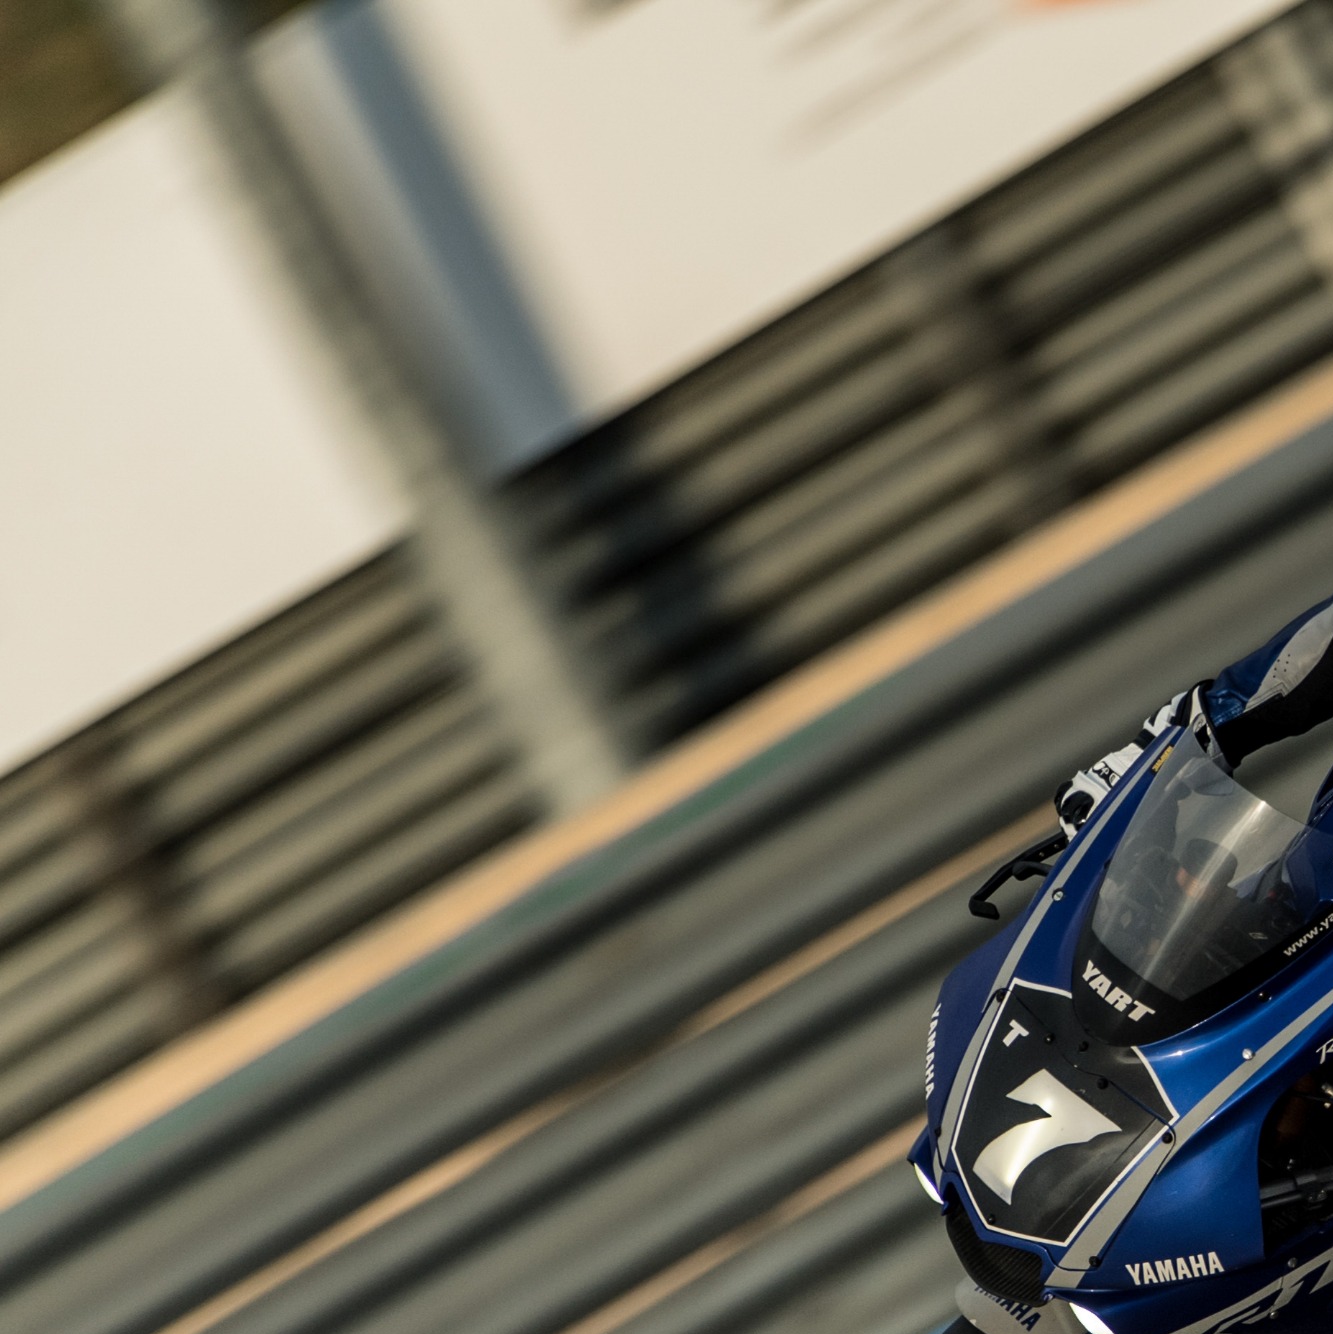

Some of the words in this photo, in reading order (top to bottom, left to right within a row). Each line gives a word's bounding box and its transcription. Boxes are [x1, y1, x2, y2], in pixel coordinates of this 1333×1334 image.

[1081, 960, 1156, 1022] YART
[924, 1003, 942, 1101] YAMAHA
[1002, 1019, 1030, 1047] T
[972, 1067, 1123, 1206] 7
[1124, 1250, 1225, 1286] YAMAHA
